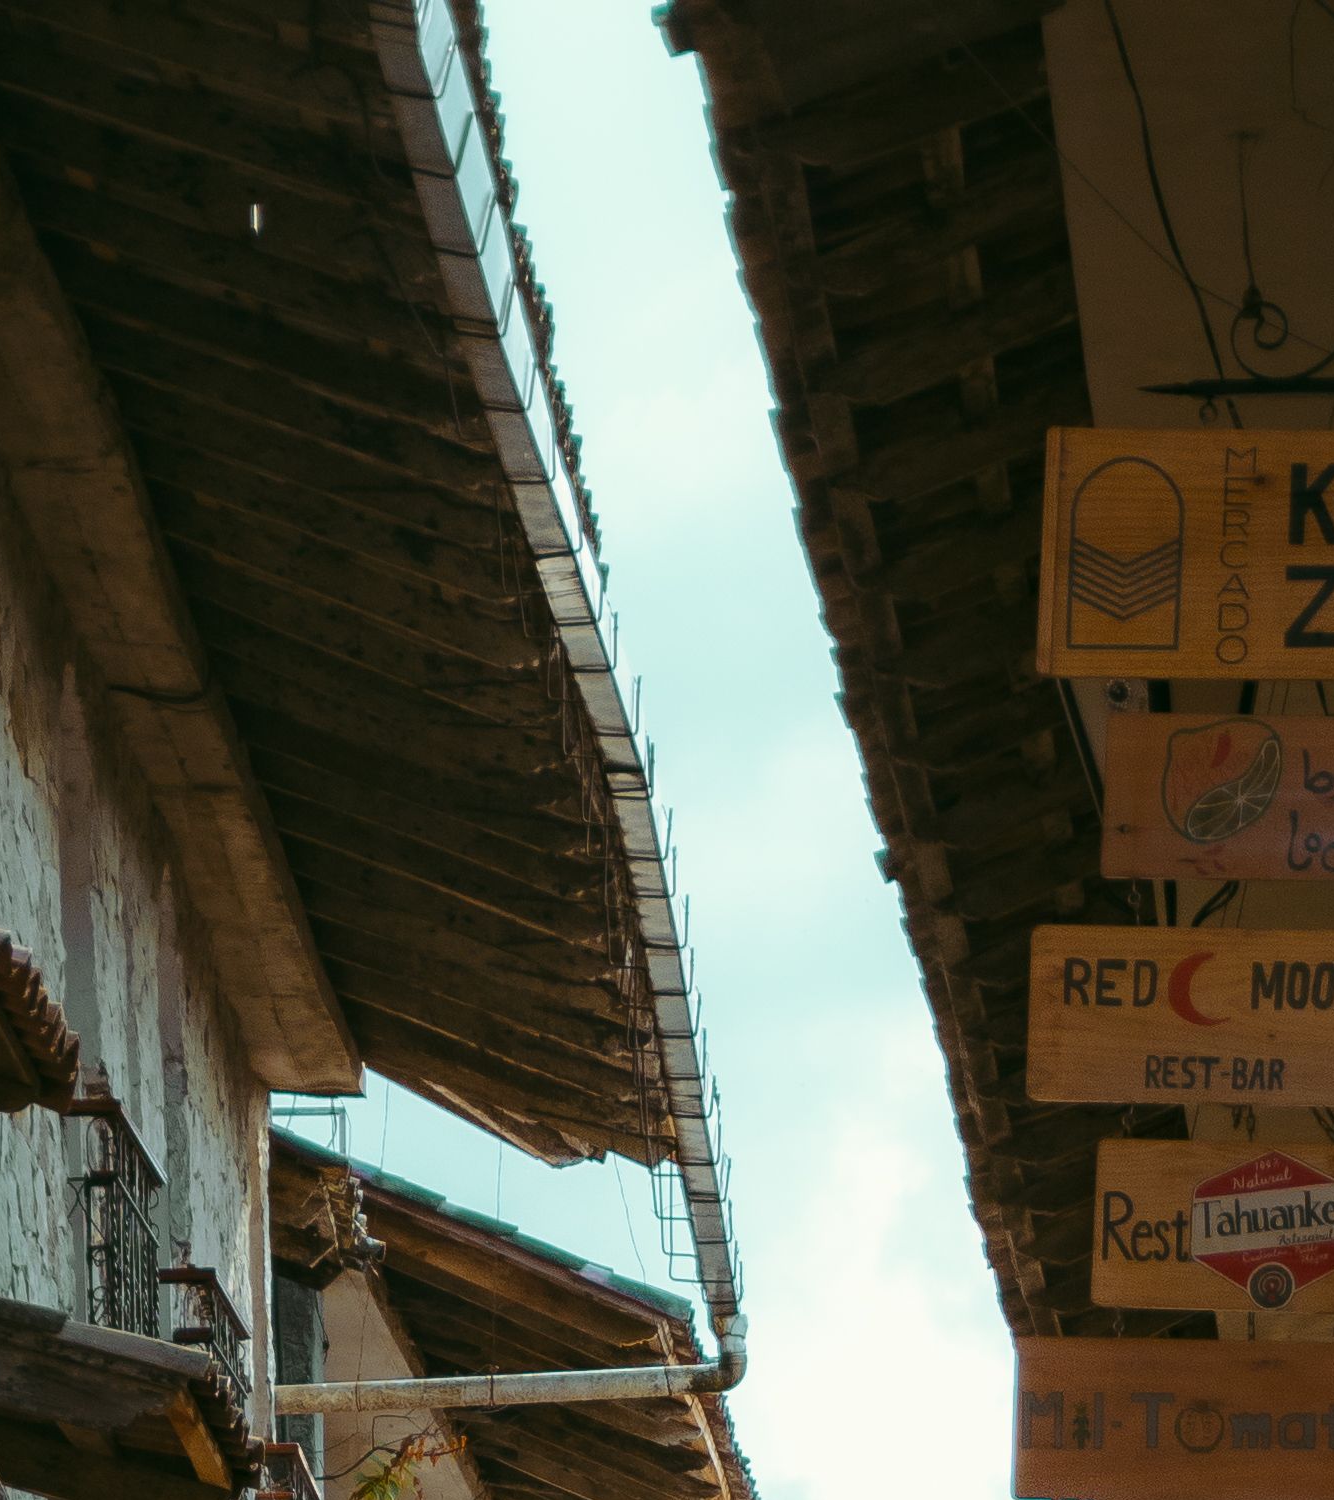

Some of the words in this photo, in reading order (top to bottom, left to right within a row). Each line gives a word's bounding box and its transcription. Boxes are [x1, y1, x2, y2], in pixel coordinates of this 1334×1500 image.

[1215, 446, 1260, 666] MERCADO
[1063, 957, 1159, 1008] RED
[1144, 1054, 1286, 1092] REST-BAR
